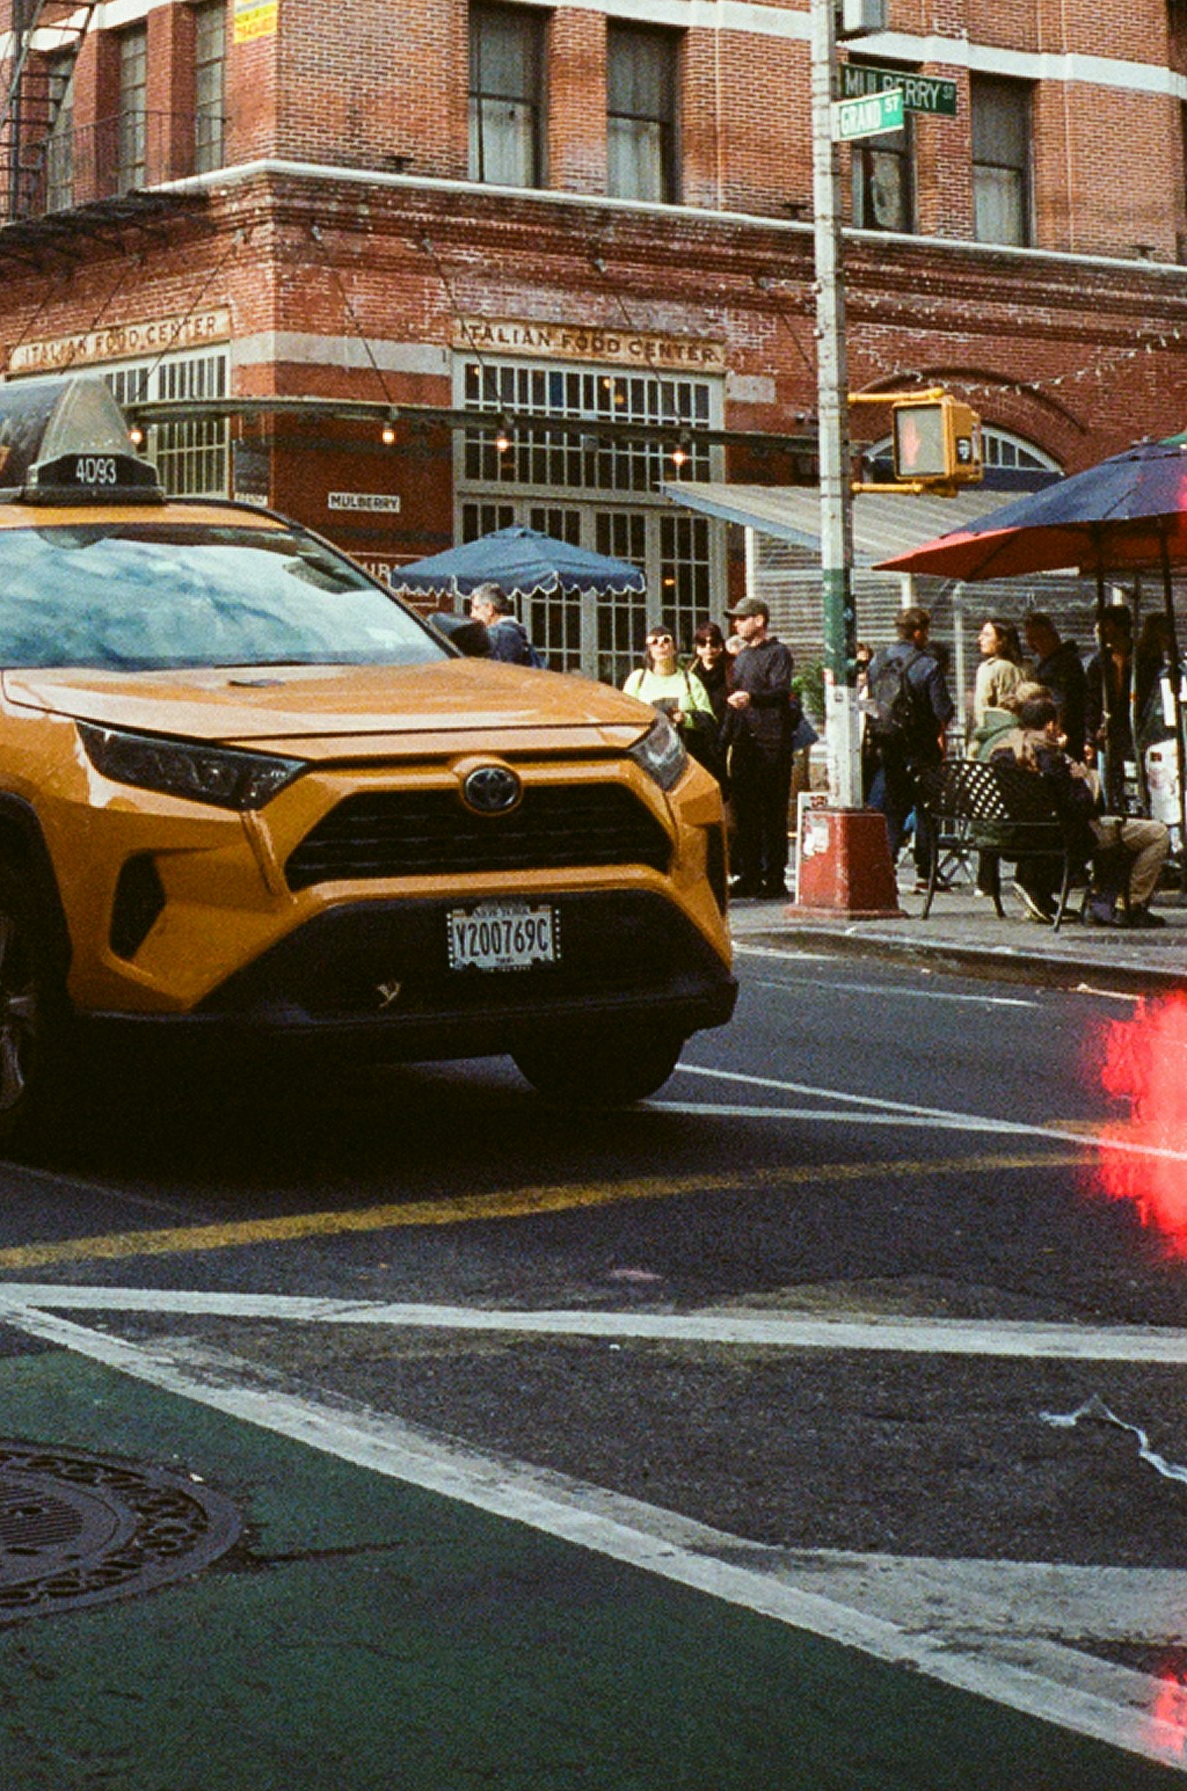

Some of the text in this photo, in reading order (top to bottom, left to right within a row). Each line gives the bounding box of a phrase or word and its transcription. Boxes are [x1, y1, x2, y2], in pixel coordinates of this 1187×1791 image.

[841, 96, 899, 136] GRAND ST
[24, 315, 215, 364] ITALIAN FOOD CENTER
[460, 323, 715, 363] ITALIAN FOOD CENTER
[75, 458, 117, 485] 4D93
[330, 495, 398, 509] MULBERRY
[455, 918, 549, 958] Y200769C
